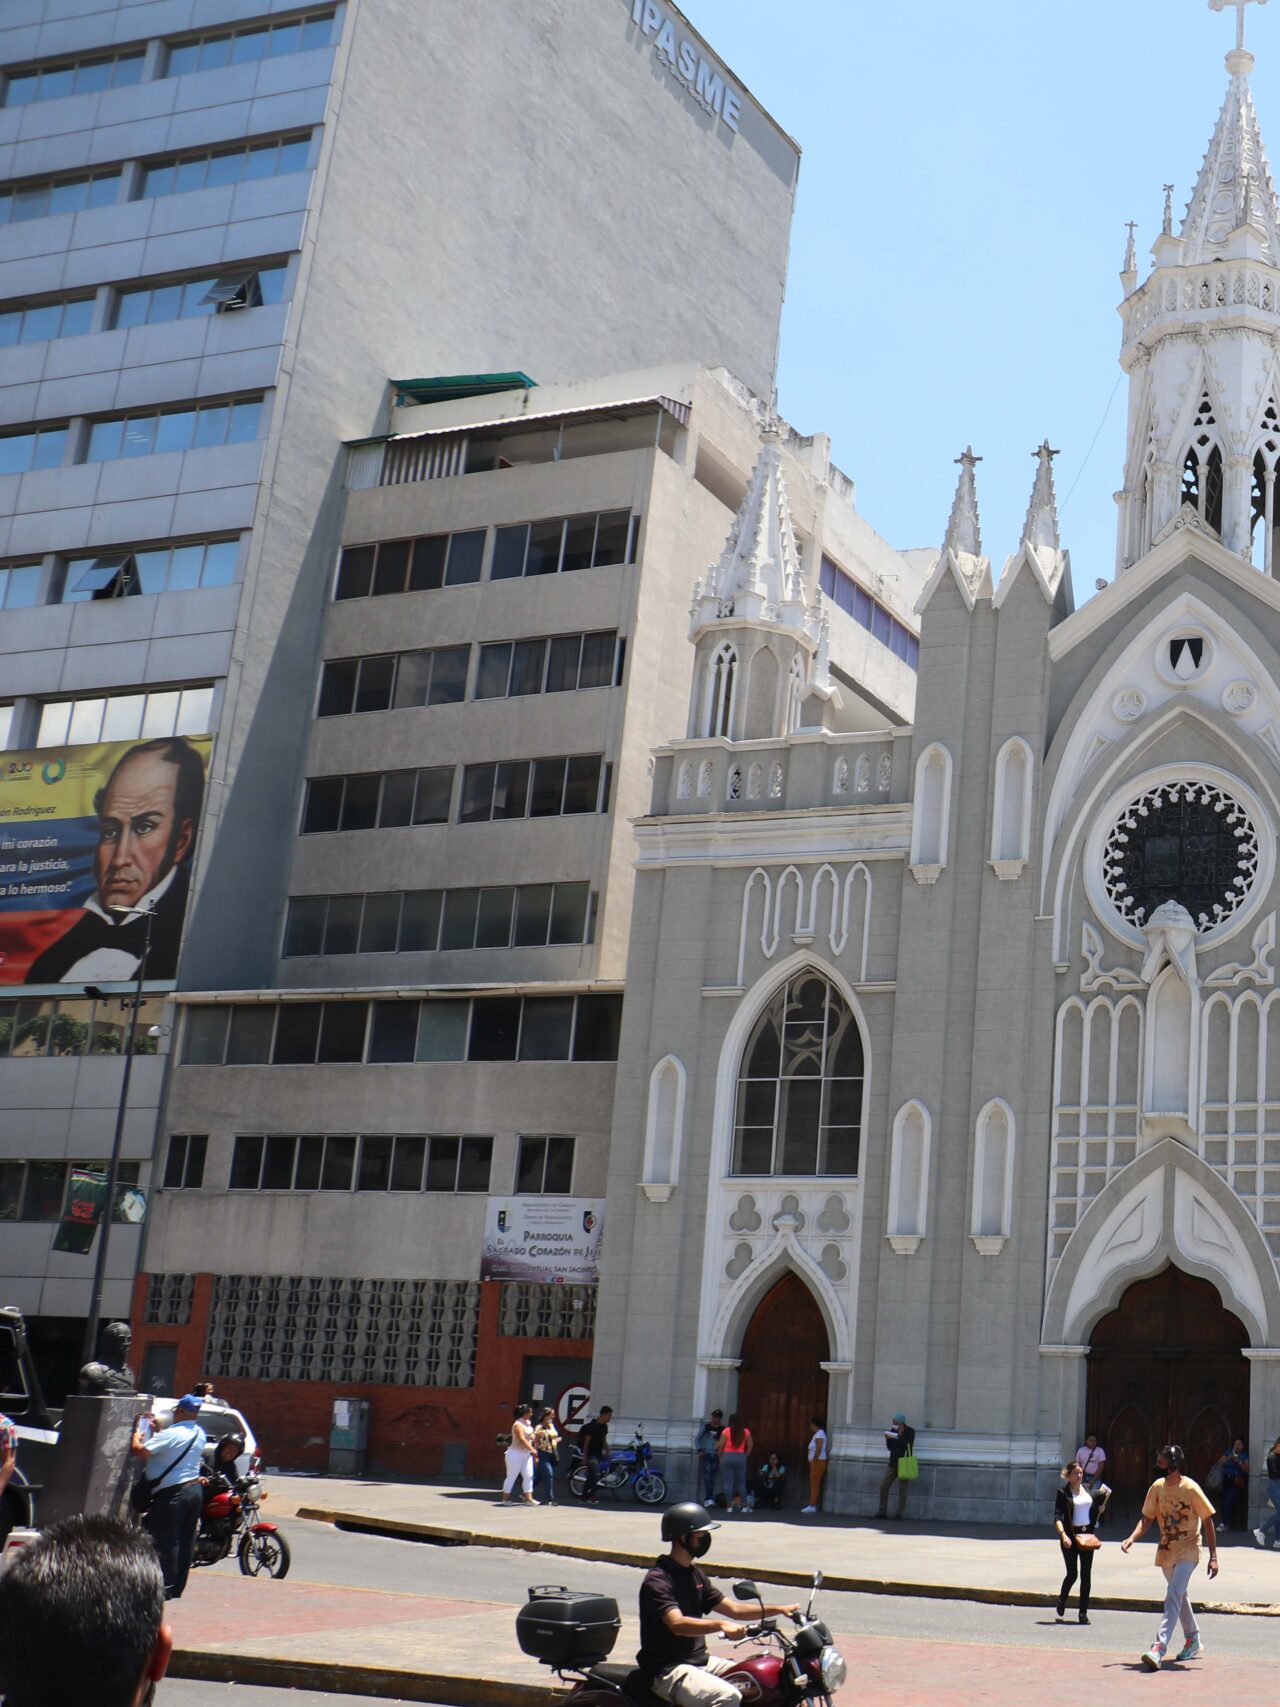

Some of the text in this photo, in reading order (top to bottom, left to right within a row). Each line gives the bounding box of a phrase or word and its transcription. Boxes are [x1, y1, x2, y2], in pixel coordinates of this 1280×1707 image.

[631, 0, 741, 134] IPASME
[1, 836, 58, 849] mi corazón
[18, 860, 27, 871] la
[27, 858, 70, 874] justicia,
[8, 884, 18, 895] lo
[567, 1394, 587, 1424] E
